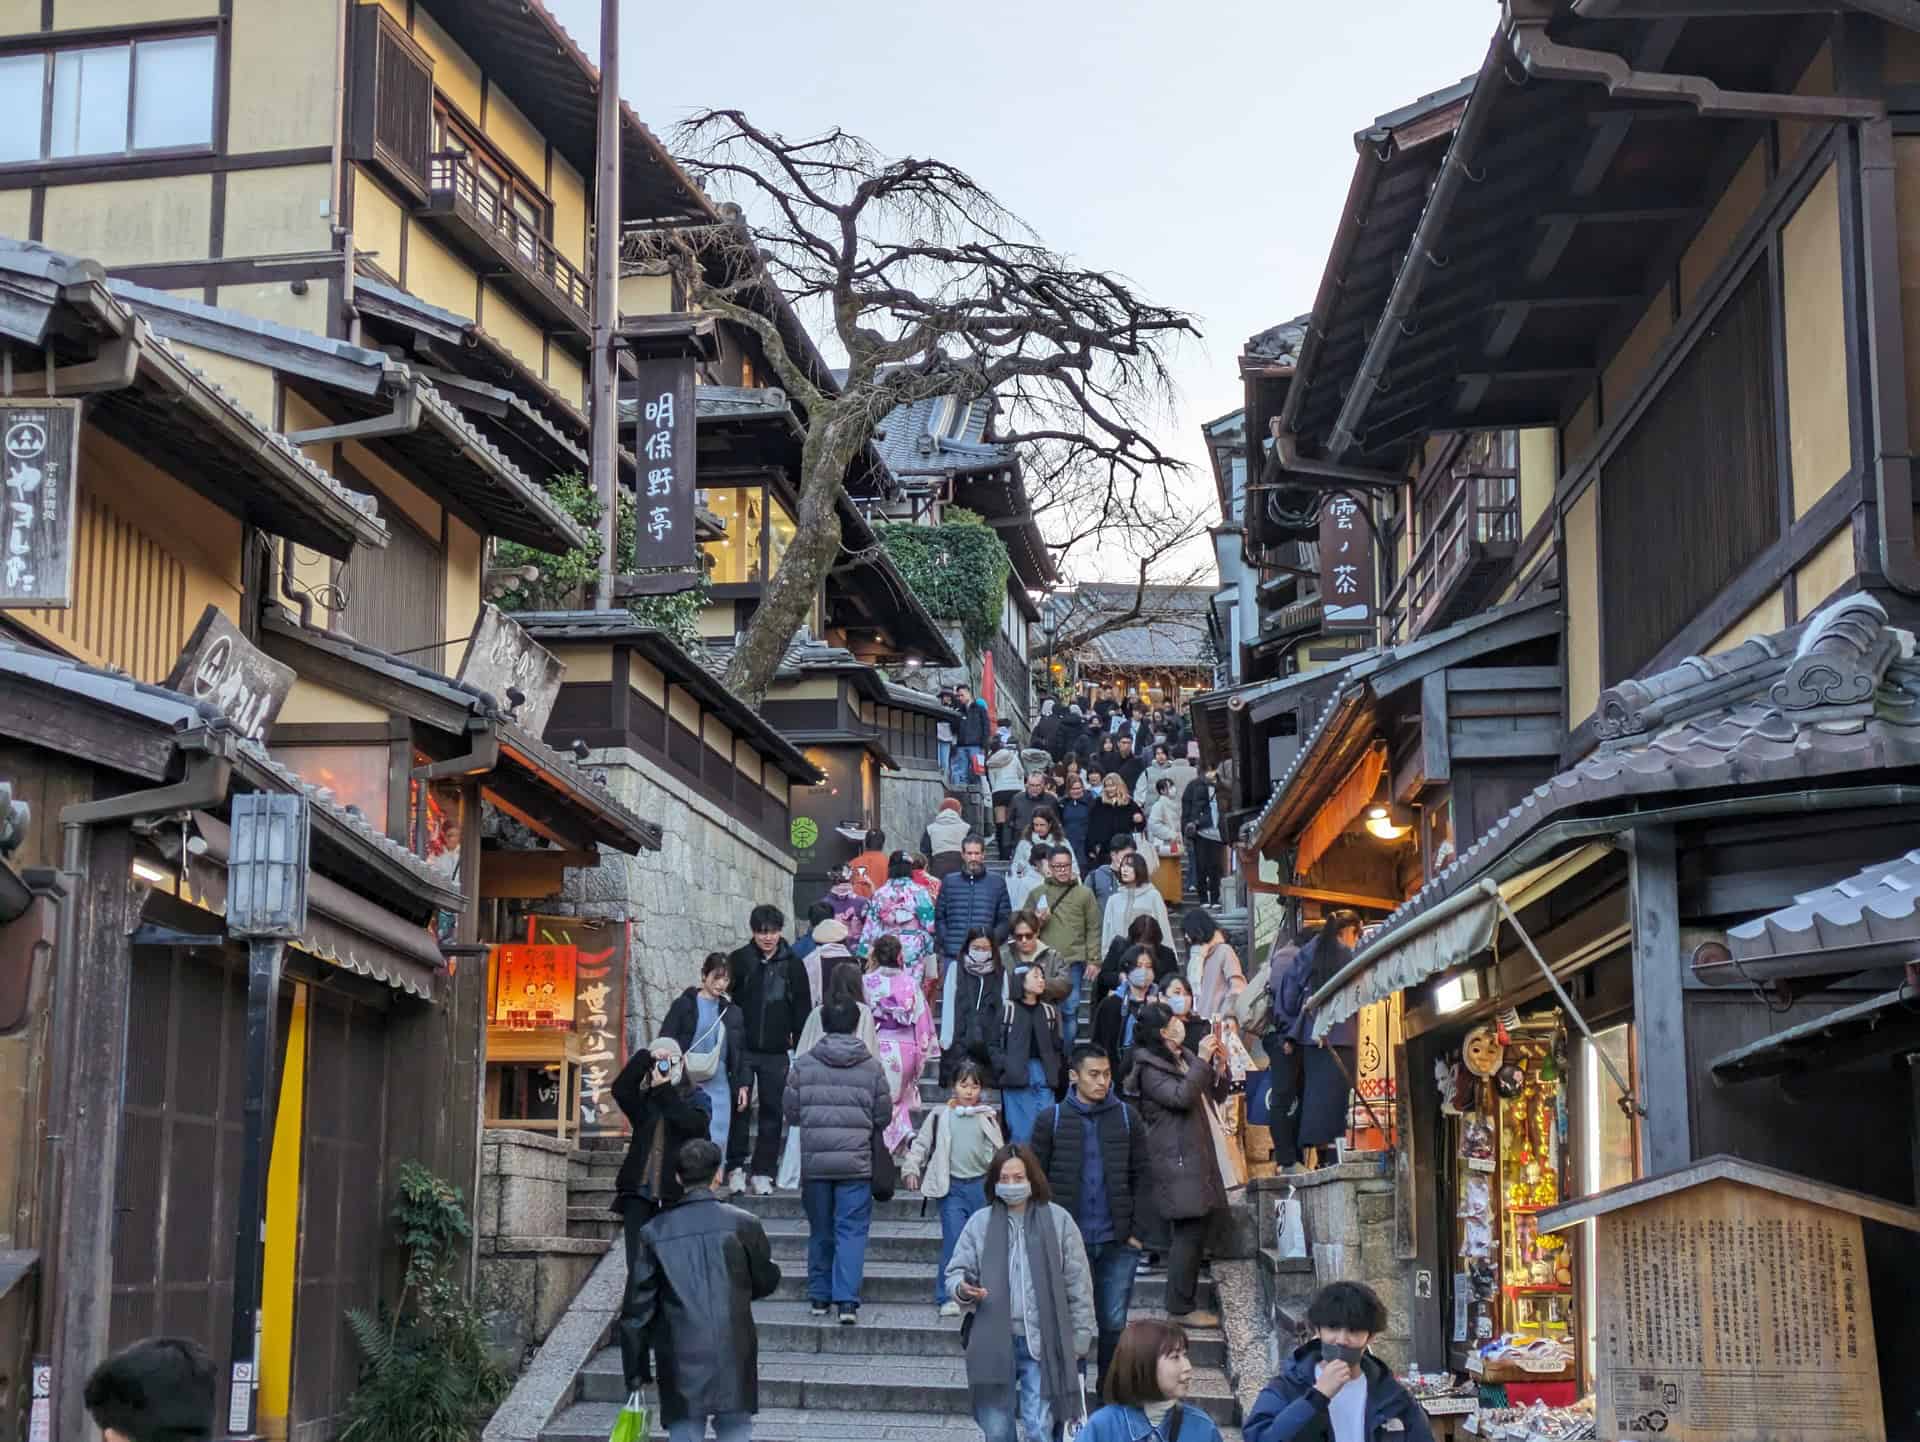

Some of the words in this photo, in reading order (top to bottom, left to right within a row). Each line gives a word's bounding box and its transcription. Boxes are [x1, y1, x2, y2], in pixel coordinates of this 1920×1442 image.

[645, 392, 675, 541] 明保野亭
[1330, 498, 1358, 594] 雲ノ茶
